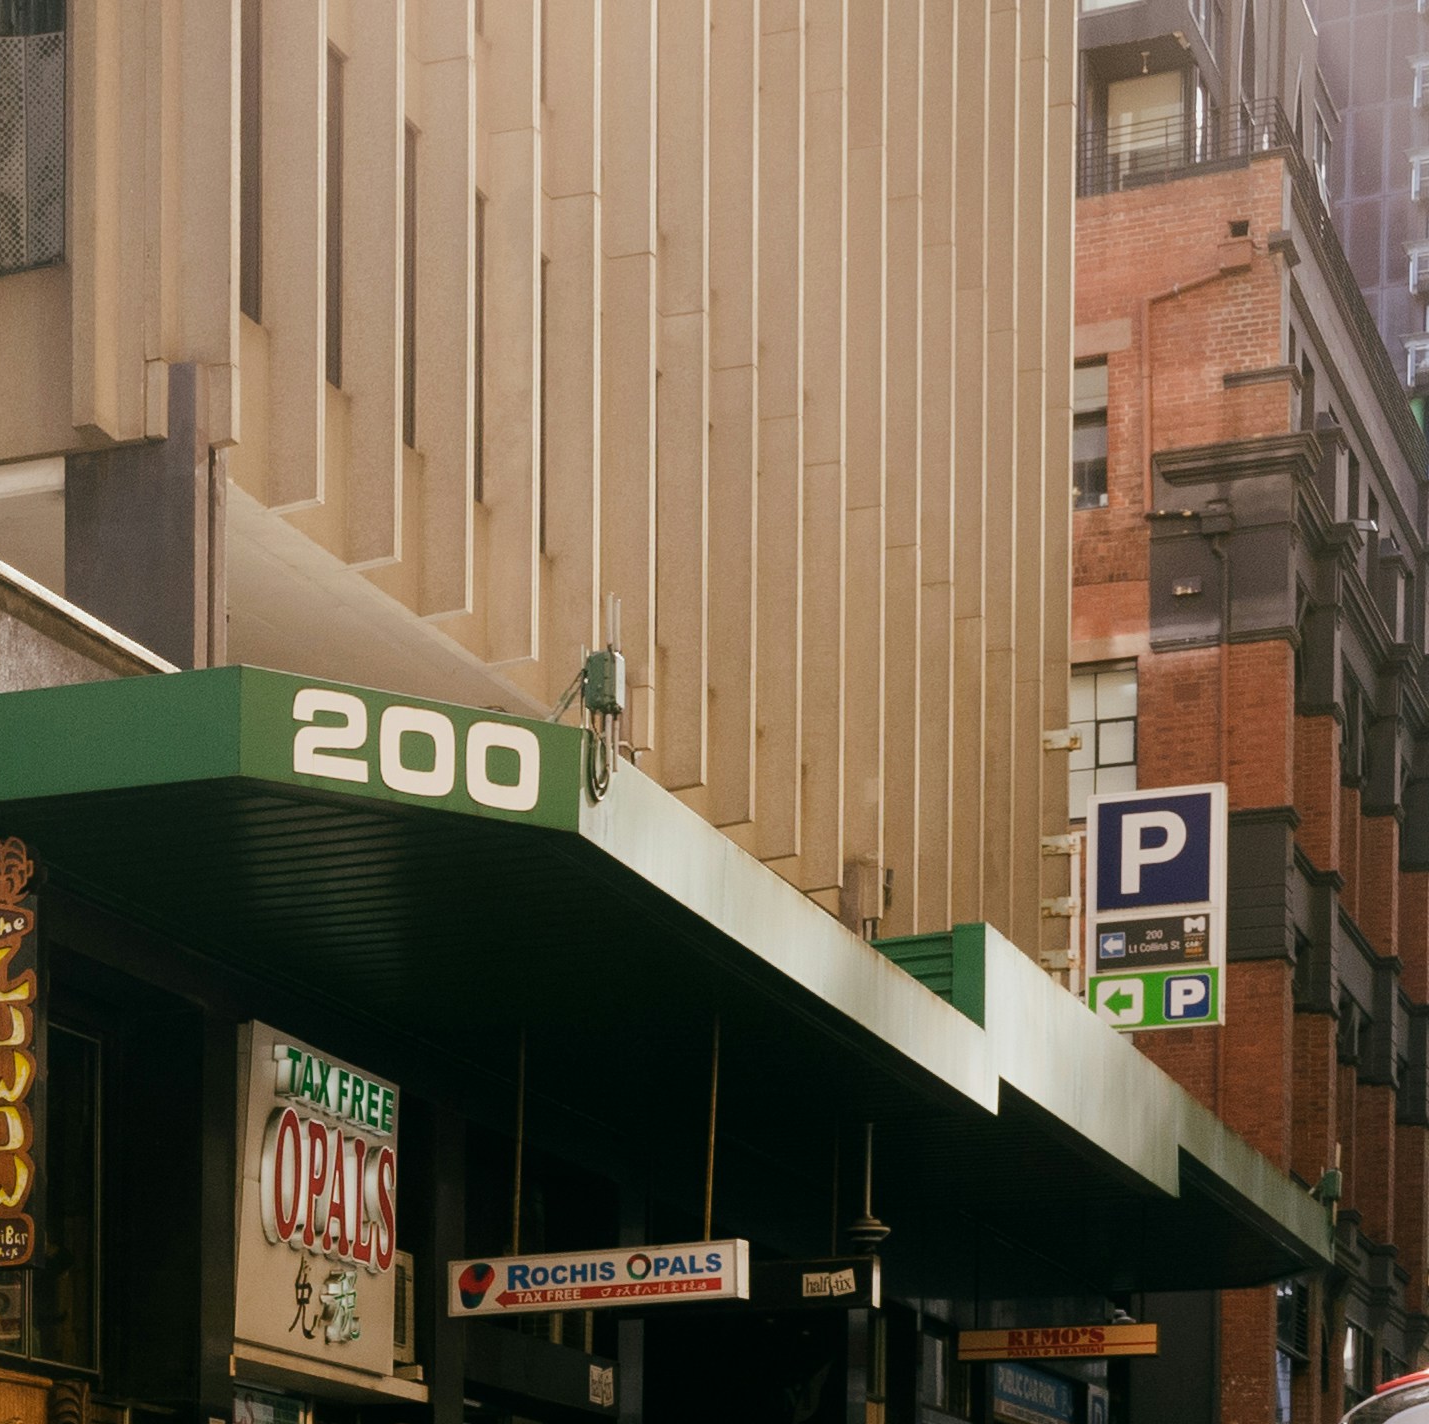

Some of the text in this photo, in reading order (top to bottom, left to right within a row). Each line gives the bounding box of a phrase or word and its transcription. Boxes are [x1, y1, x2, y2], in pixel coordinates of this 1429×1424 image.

[292, 688, 539, 812] 200
[1121, 811, 1187, 895] P
[1140, 942, 1168, 953] Collins
[1146, 930, 1163, 941] 200
[1170, 979, 1206, 1017] P
[287, 1046, 394, 1134] TAX FREE
[274, 1107, 395, 1273] OPALS
[507, 1253, 722, 1291] ROCHIS OPALS
[516, 1289, 581, 1304] TAX FREE
[1007, 1327, 1106, 1348] REMO'S
[1007, 1349, 1040, 1357] PASTA
